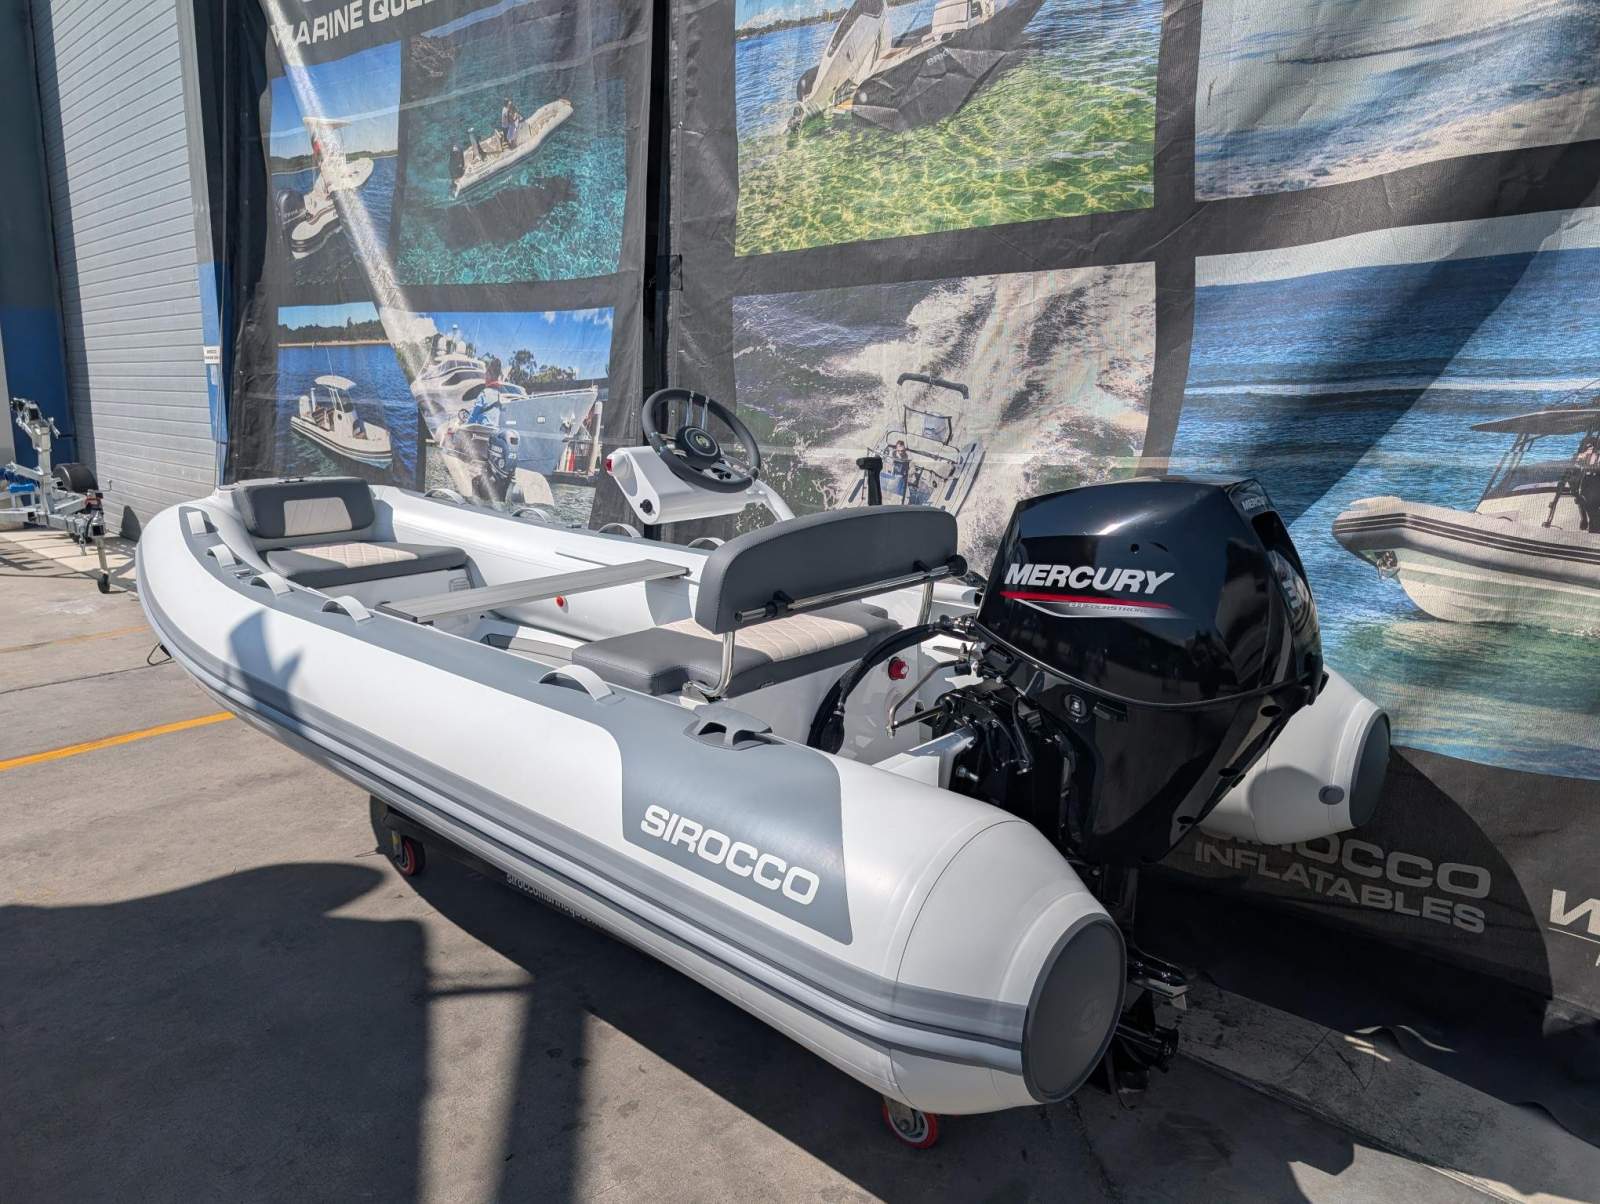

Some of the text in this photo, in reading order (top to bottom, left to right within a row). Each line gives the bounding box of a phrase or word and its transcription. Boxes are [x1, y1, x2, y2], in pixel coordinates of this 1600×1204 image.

[1004, 563, 1175, 594] MERCURY
[640, 804, 820, 905] SIROCCO
[1194, 840, 1486, 934] INFLATABLES
